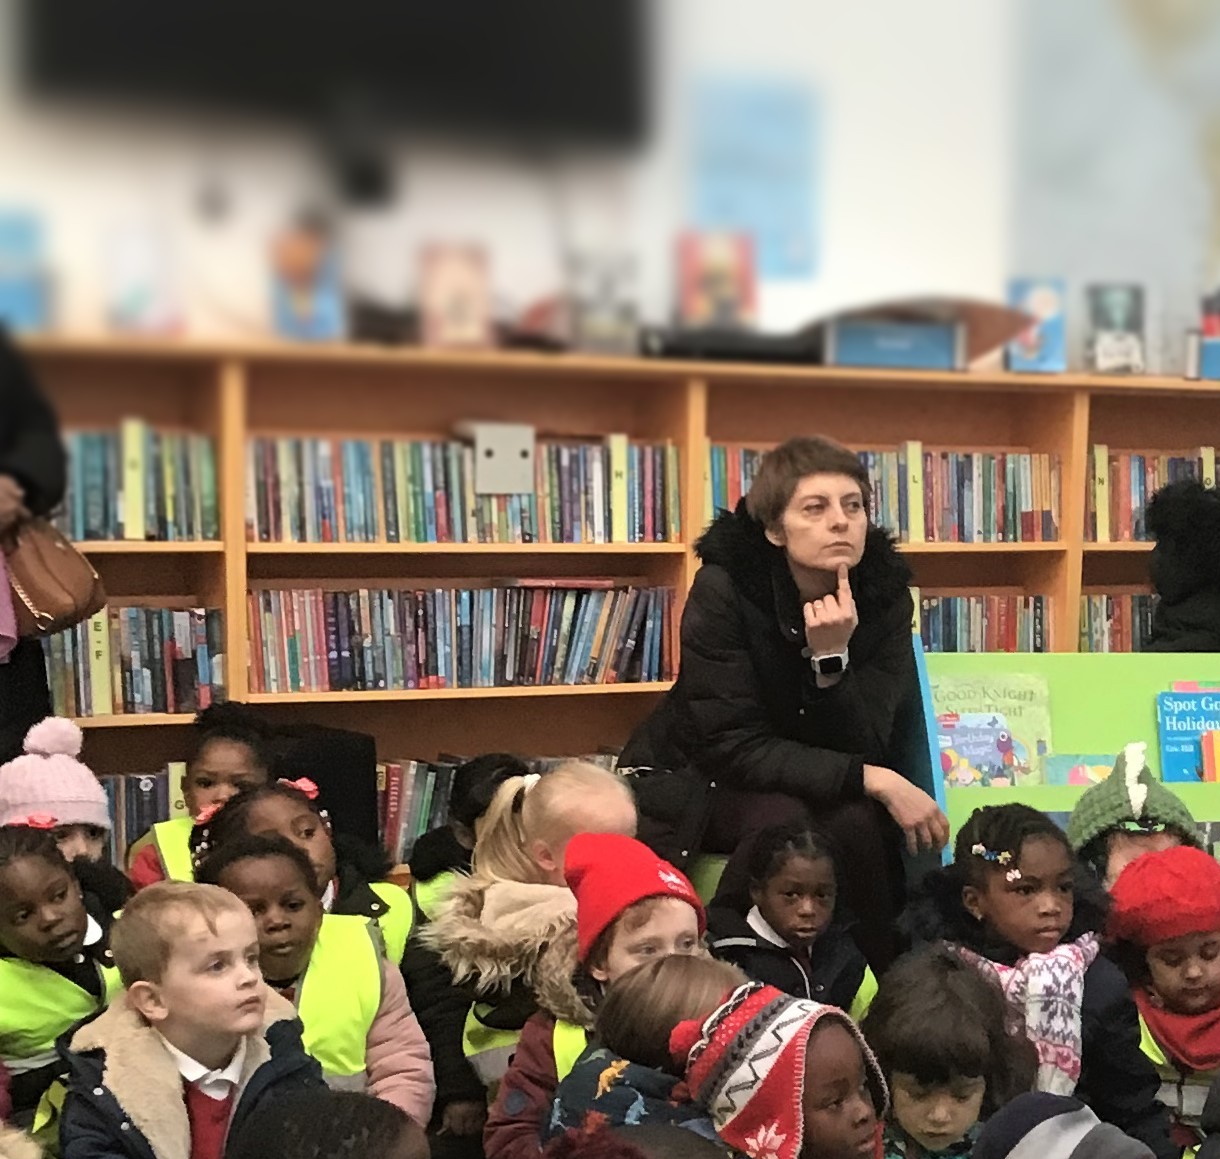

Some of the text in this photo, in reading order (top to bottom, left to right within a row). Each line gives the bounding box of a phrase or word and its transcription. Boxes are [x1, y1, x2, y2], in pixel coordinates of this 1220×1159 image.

[912, 475, 918, 484] L
[982, 685, 1036, 703] KNIGHT
[1163, 696, 1198, 714] Spot
[174, 800, 185, 810] G
